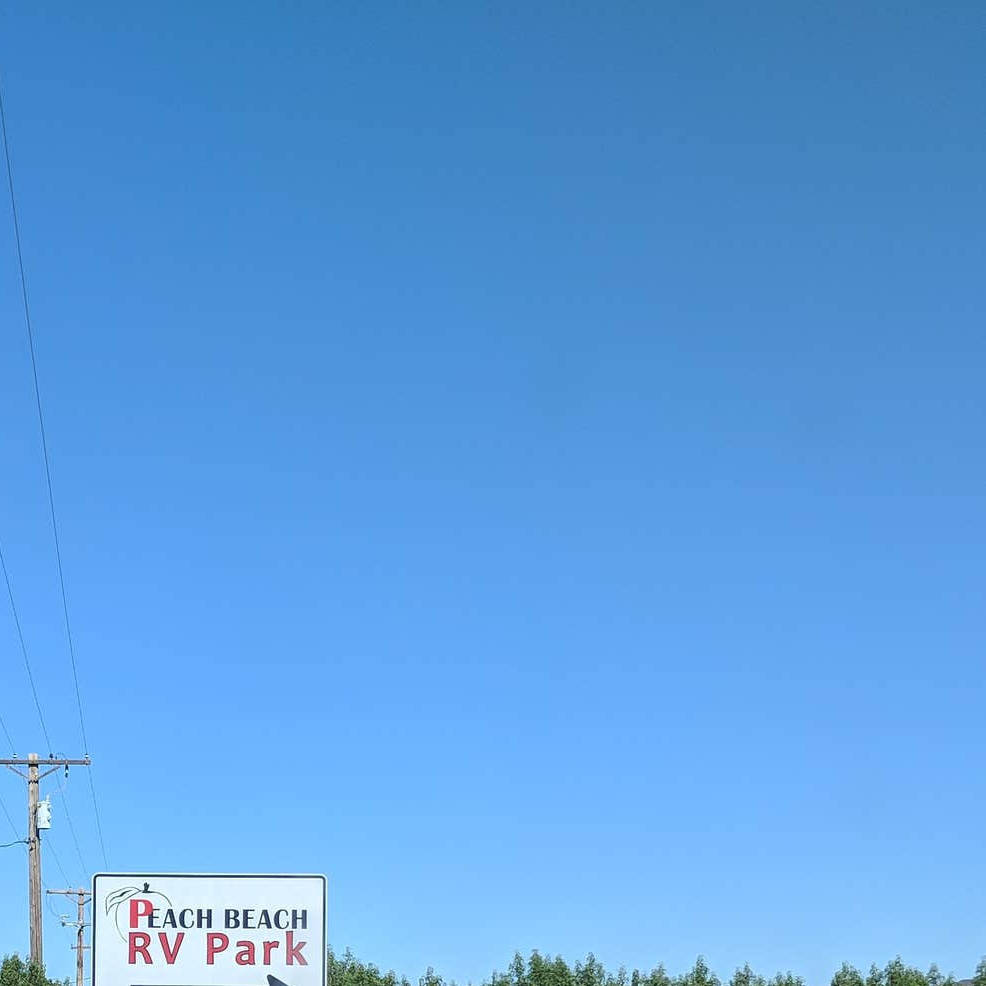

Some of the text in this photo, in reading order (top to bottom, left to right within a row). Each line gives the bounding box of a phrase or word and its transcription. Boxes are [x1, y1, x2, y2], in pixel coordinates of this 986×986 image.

[129, 899, 307, 929] PEACH BEACH
[127, 930, 308, 966] RV Park
